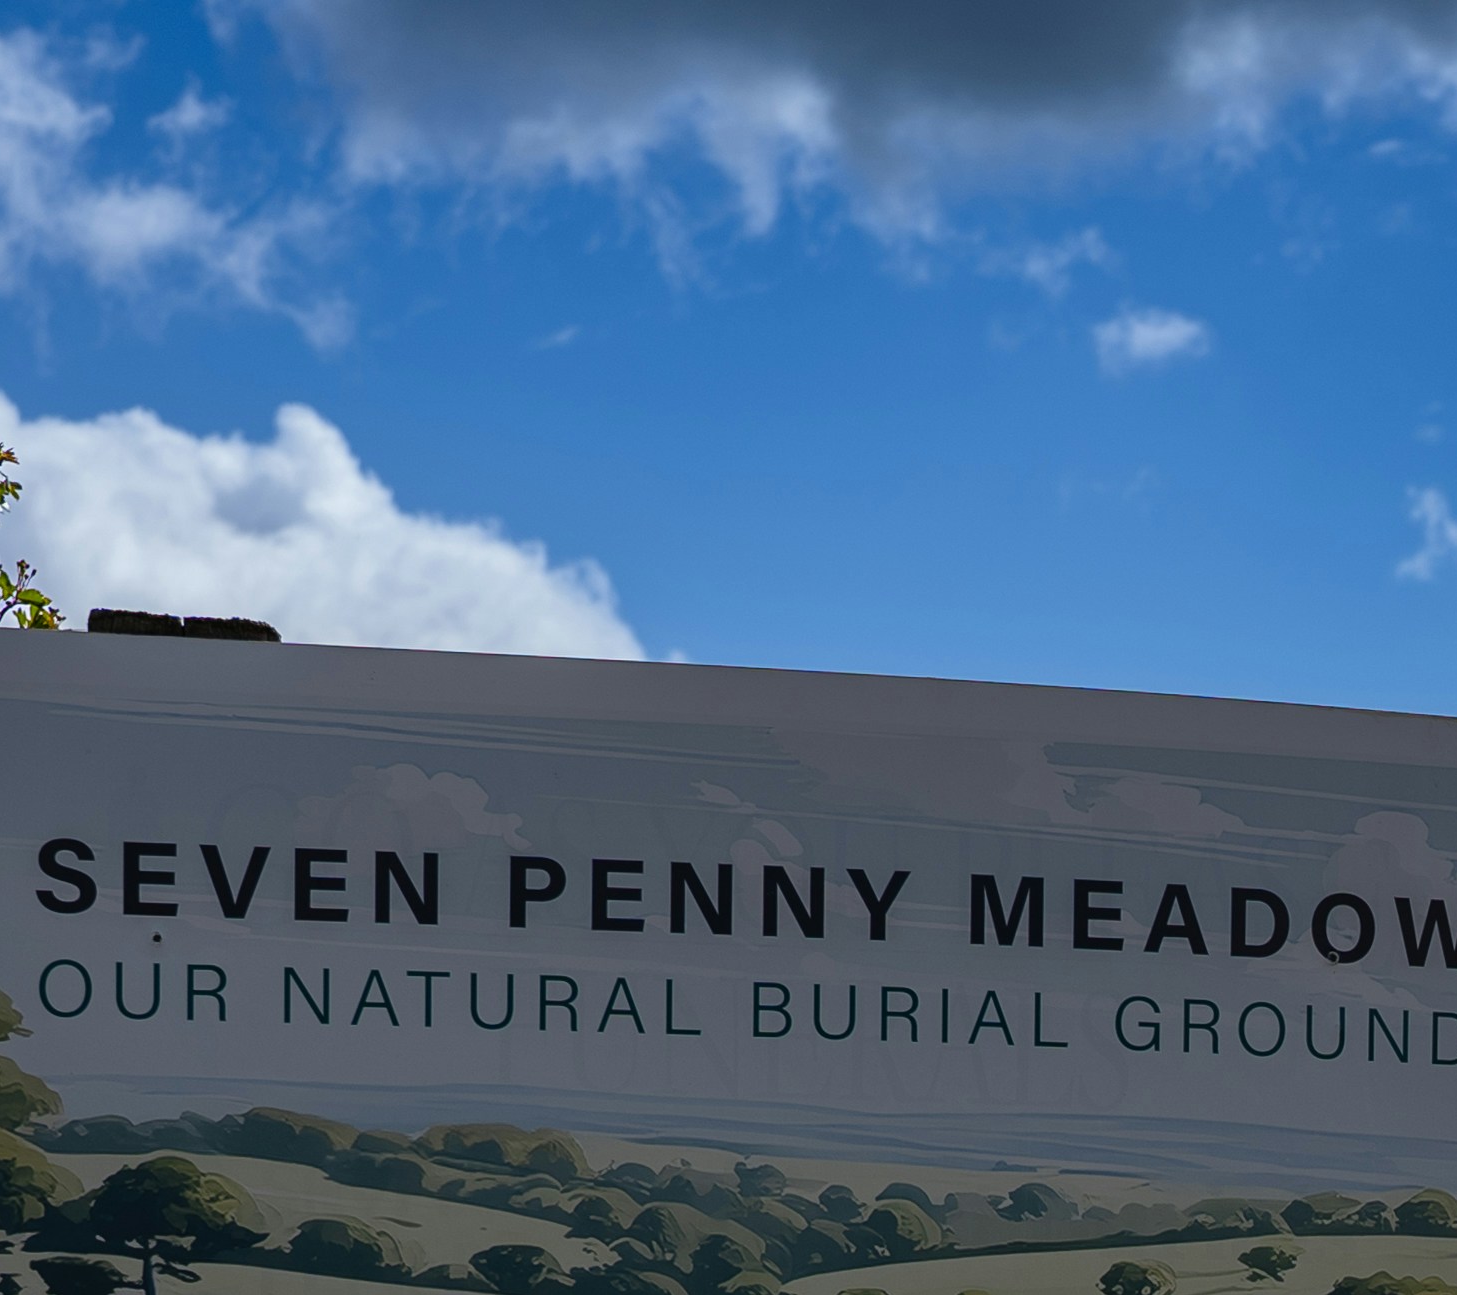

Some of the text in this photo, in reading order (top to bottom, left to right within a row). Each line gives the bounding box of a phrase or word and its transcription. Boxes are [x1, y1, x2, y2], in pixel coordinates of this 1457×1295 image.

[35, 837, 439, 926] SEVEN
[509, 855, 912, 941] PENNY
[38, 958, 227, 1022] OUR
[283, 966, 702, 1036] NATURAL
[752, 981, 1069, 1048] BURIAL
